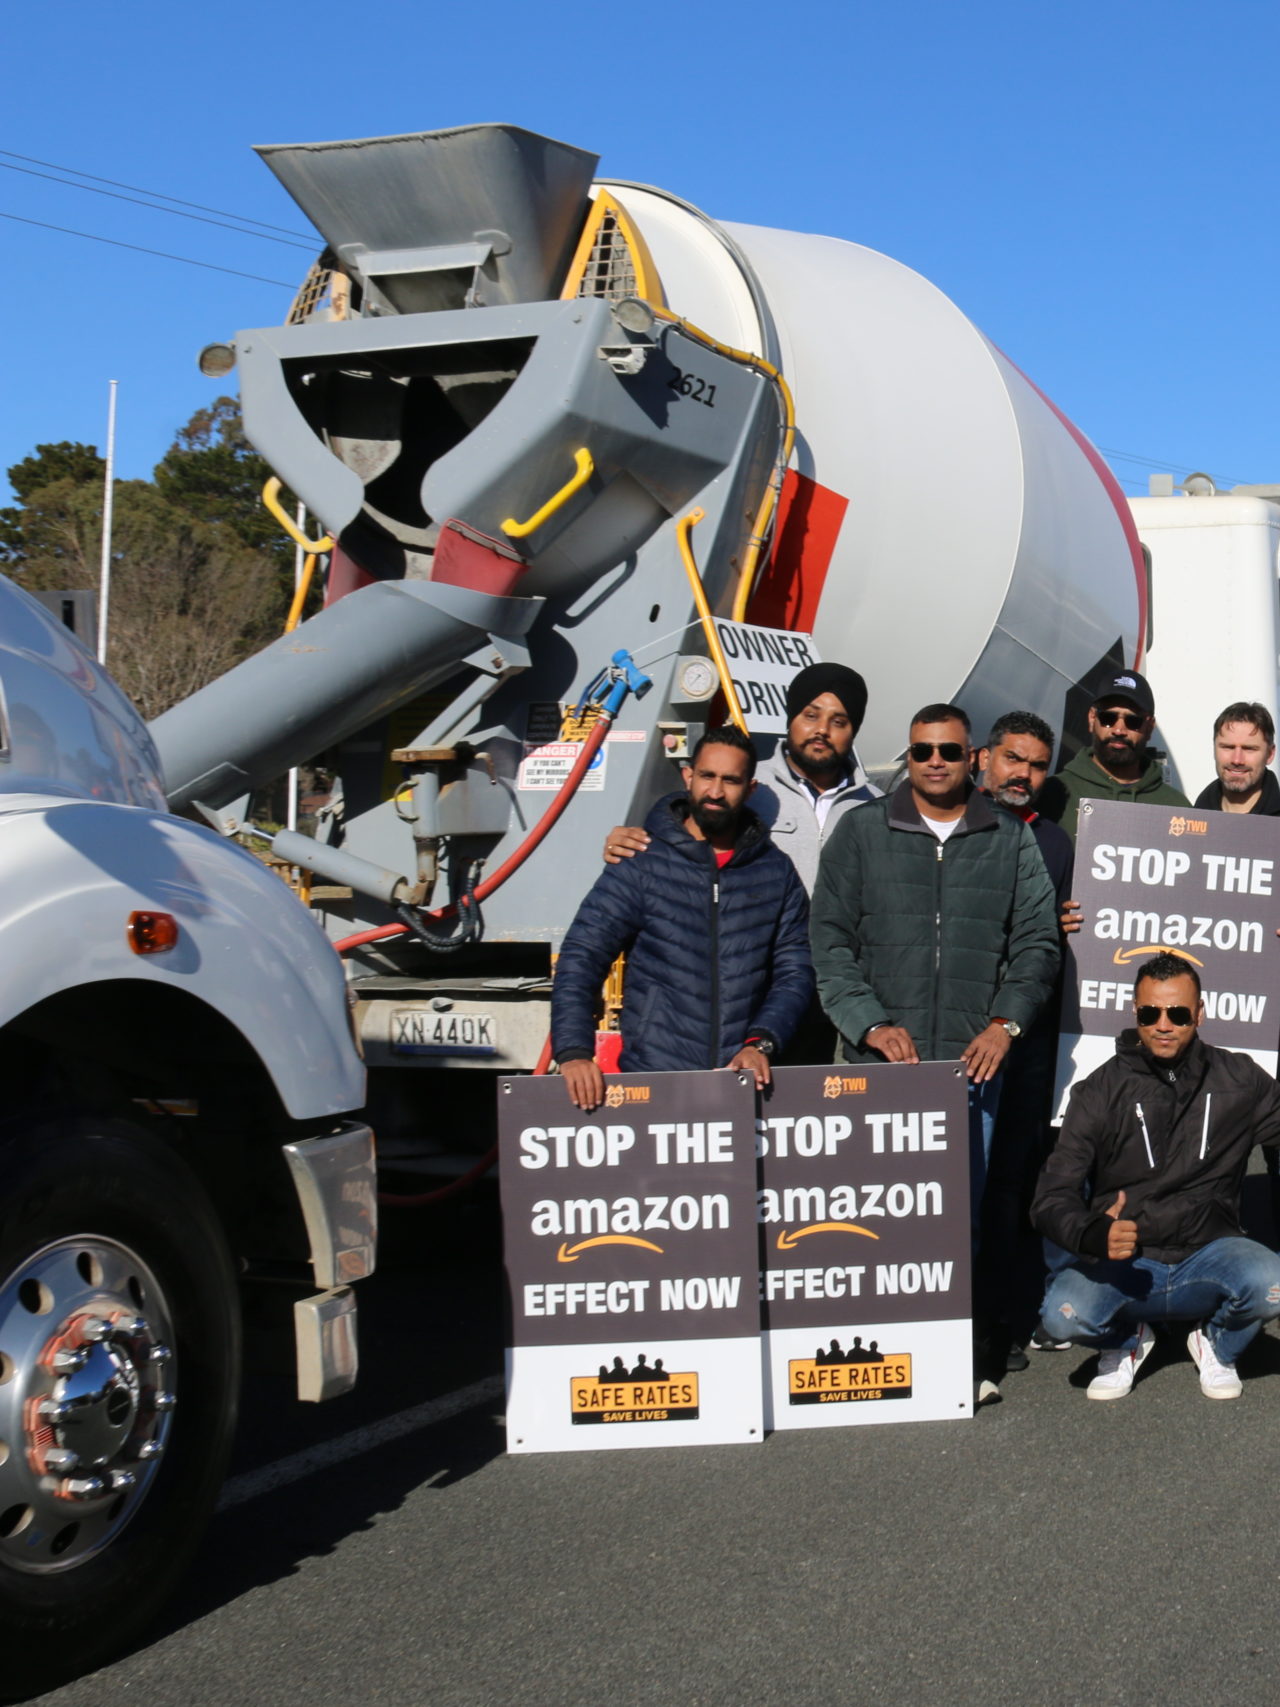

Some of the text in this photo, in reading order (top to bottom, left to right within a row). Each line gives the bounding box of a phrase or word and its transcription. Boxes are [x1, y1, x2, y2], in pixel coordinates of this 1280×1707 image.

[667, 366, 717, 408] 2621
[718, 623, 815, 668] OWNER
[731, 678, 789, 717] DRIV
[527, 746, 577, 756] DANGER
[1186, 820, 1208, 833] TWU
[1091, 844, 1274, 896] STOP THE
[1094, 907, 1263, 953] amazon
[1079, 979, 1134, 1011] EFF
[624, 1086, 650, 1100] TWU
[843, 1077, 867, 1091] TWU
[519, 1121, 734, 1169] STOP THE
[865, 1111, 947, 1154] THE
[530, 1193, 729, 1236] amazon
[756, 1181, 943, 1223] amazon
[523, 1277, 740, 1316] EFFECT NOW
[759, 1261, 953, 1300] FFECT NOW
[577, 1384, 692, 1408] SAFE RATES
[794, 1365, 906, 1389] SAFE RATES
[819, 1390, 882, 1402] SAVE LIVES
[602, 1410, 668, 1421] SAVE LIVES
